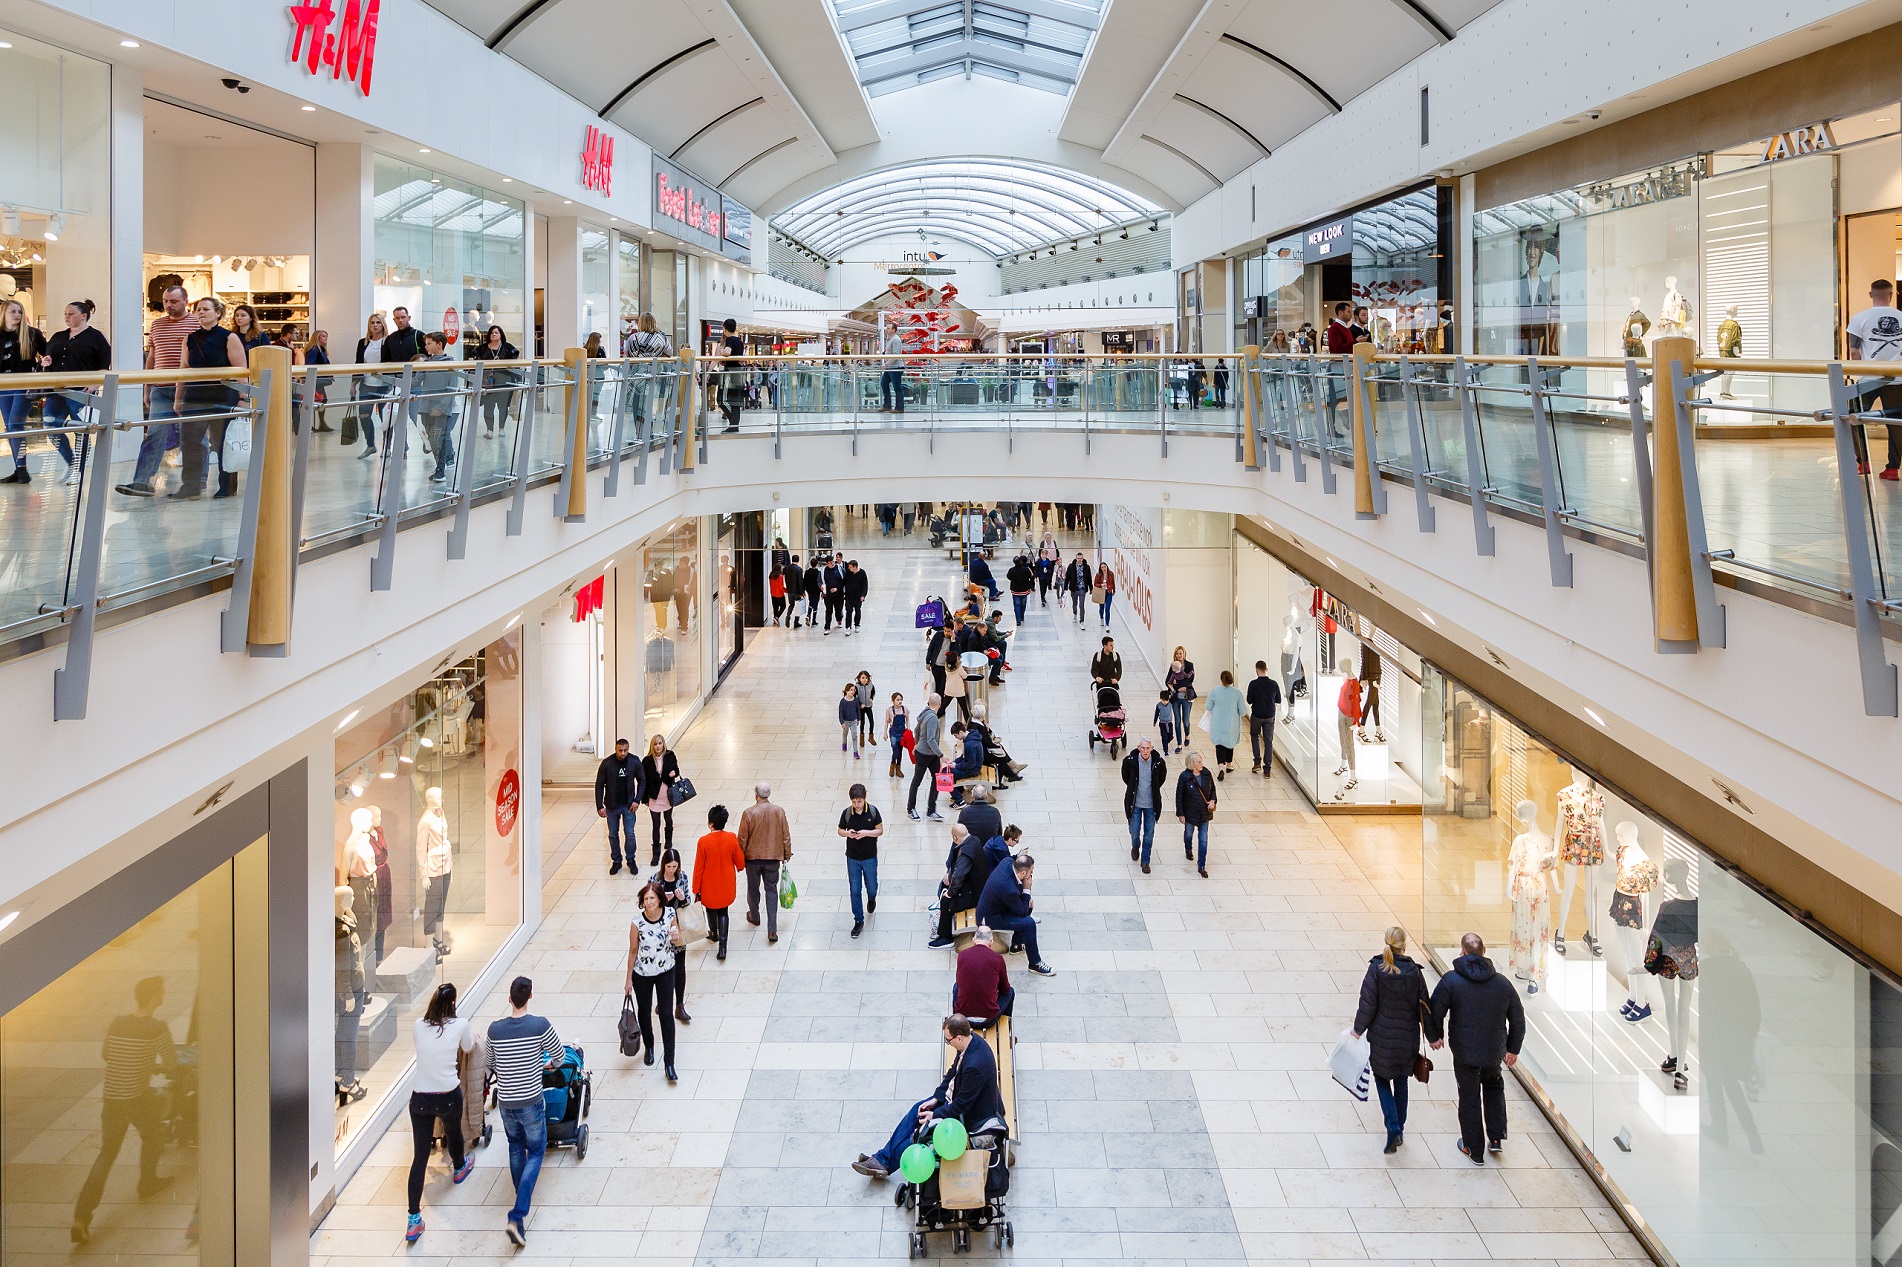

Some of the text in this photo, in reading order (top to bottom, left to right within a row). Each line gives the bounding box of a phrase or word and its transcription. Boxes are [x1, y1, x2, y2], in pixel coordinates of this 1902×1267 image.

[288, 0, 380, 97] H&M
[1760, 122, 1833, 163] ZARA
[581, 125, 615, 198] H&M
[1608, 178, 1658, 210] ZARA
[1308, 224, 1345, 246] NEW LOOK
[903, 250, 926, 262] intu
[503, 782, 512, 798] MID
[498, 789, 518, 816] SEASON
[501, 806, 515, 826] SALE
[946, 1171, 979, 1179] PRIMARK
